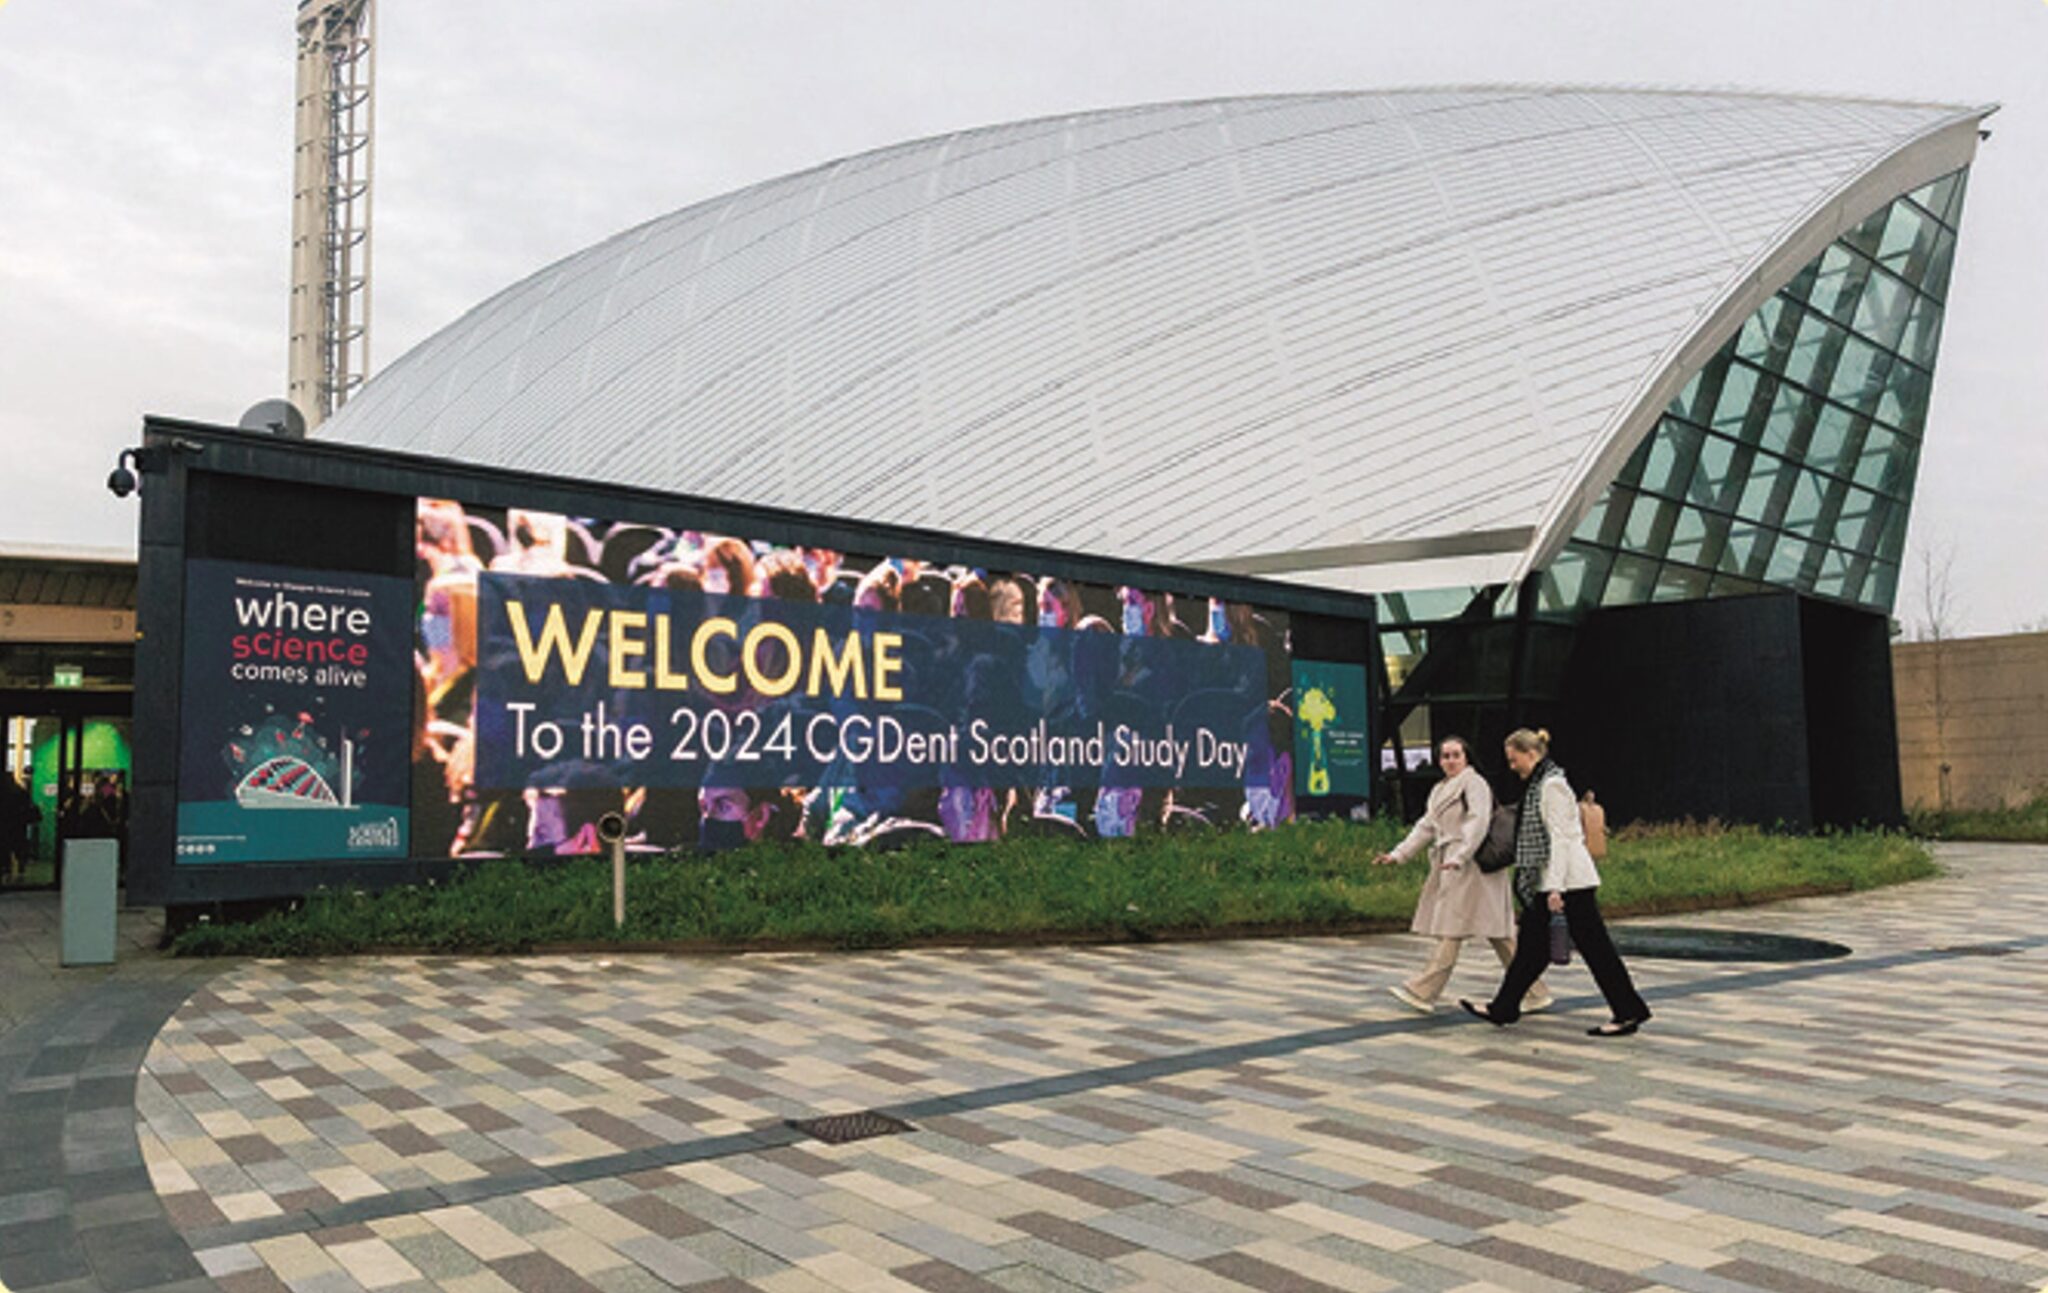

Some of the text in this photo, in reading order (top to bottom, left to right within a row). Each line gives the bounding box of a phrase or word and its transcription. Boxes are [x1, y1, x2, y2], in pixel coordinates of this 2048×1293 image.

[234, 591, 371, 635] where
[231, 629, 369, 666] science
[505, 600, 903, 701] WELCOME
[230, 662, 368, 688] comes alive
[506, 701, 1248, 778] To the 2024 CGDent Scotland Study Day
